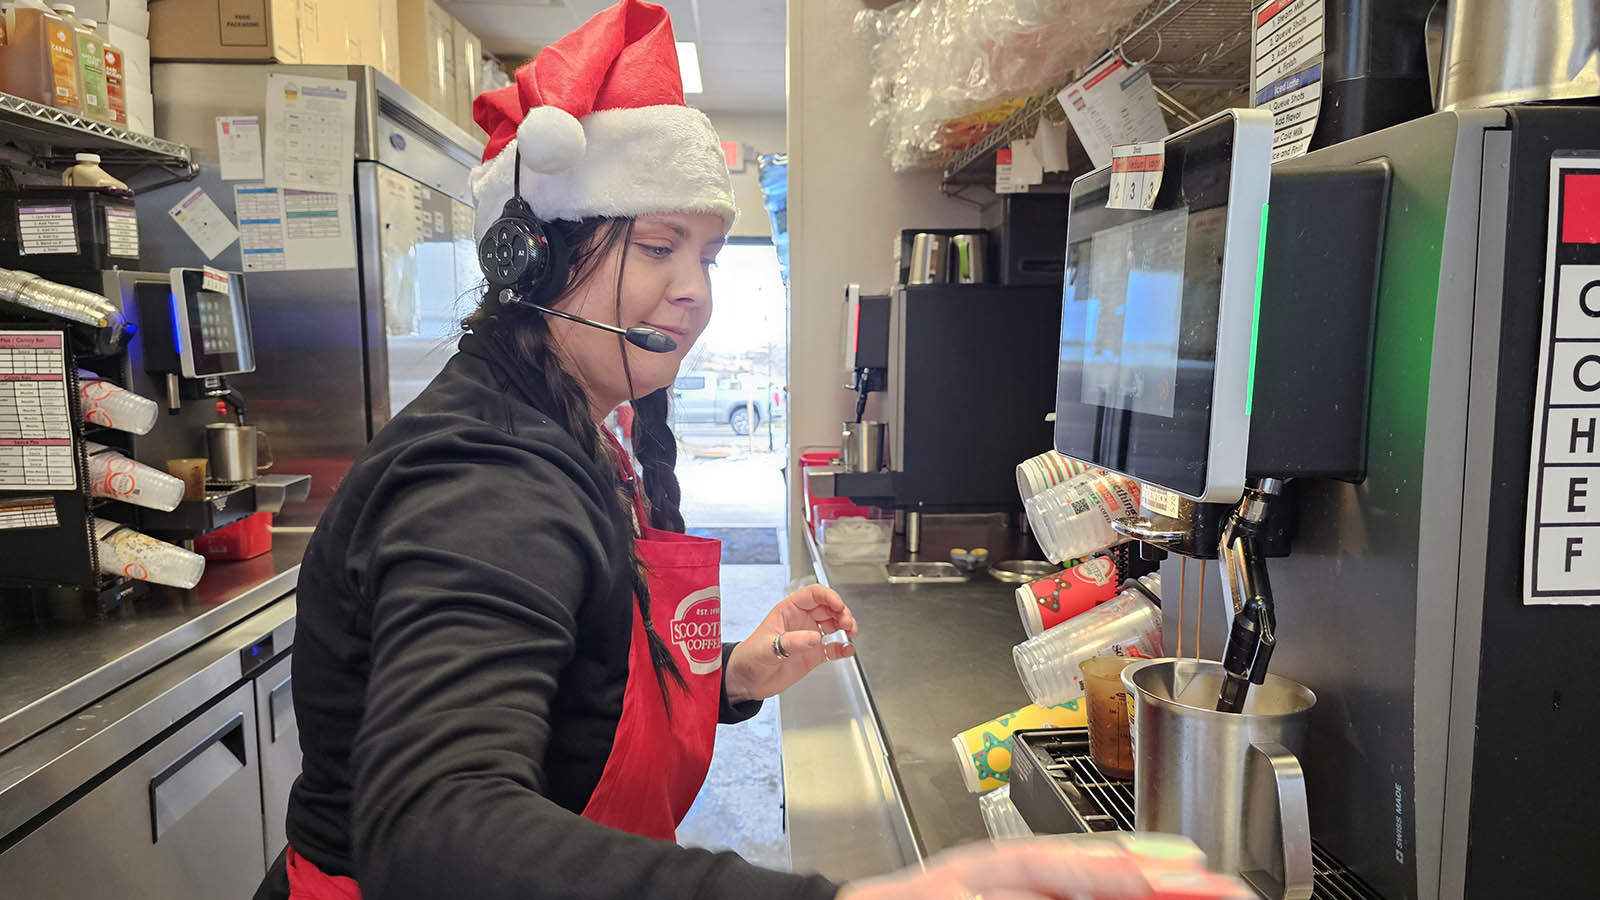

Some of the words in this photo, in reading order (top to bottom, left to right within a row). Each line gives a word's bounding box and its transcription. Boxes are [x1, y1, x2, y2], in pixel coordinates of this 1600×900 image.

[1274, 27, 1292, 43] Queue
[1292, 16, 1307, 31] Shots
[1287, 35, 1305, 50] Flavor
[1286, 78, 1300, 90] Latte
[1272, 98, 1290, 111] Queue
[1290, 92, 1305, 103] Shots
[1274, 115, 1286, 127] Add
[1285, 111, 1301, 123] Flavor
[1280, 130, 1292, 142] Cold
[1293, 126, 1304, 137] Milk
[1280, 148, 1290, 158] and
[1129, 181, 1136, 200] 3
[1569, 417, 1597, 453] H
[1567, 477, 1588, 513] E
[1564, 537, 1583, 572] F
[674, 622, 721, 640] SCOOT
[1394, 782, 1402, 815] MADE
[1395, 816, 1403, 849] SWISS
